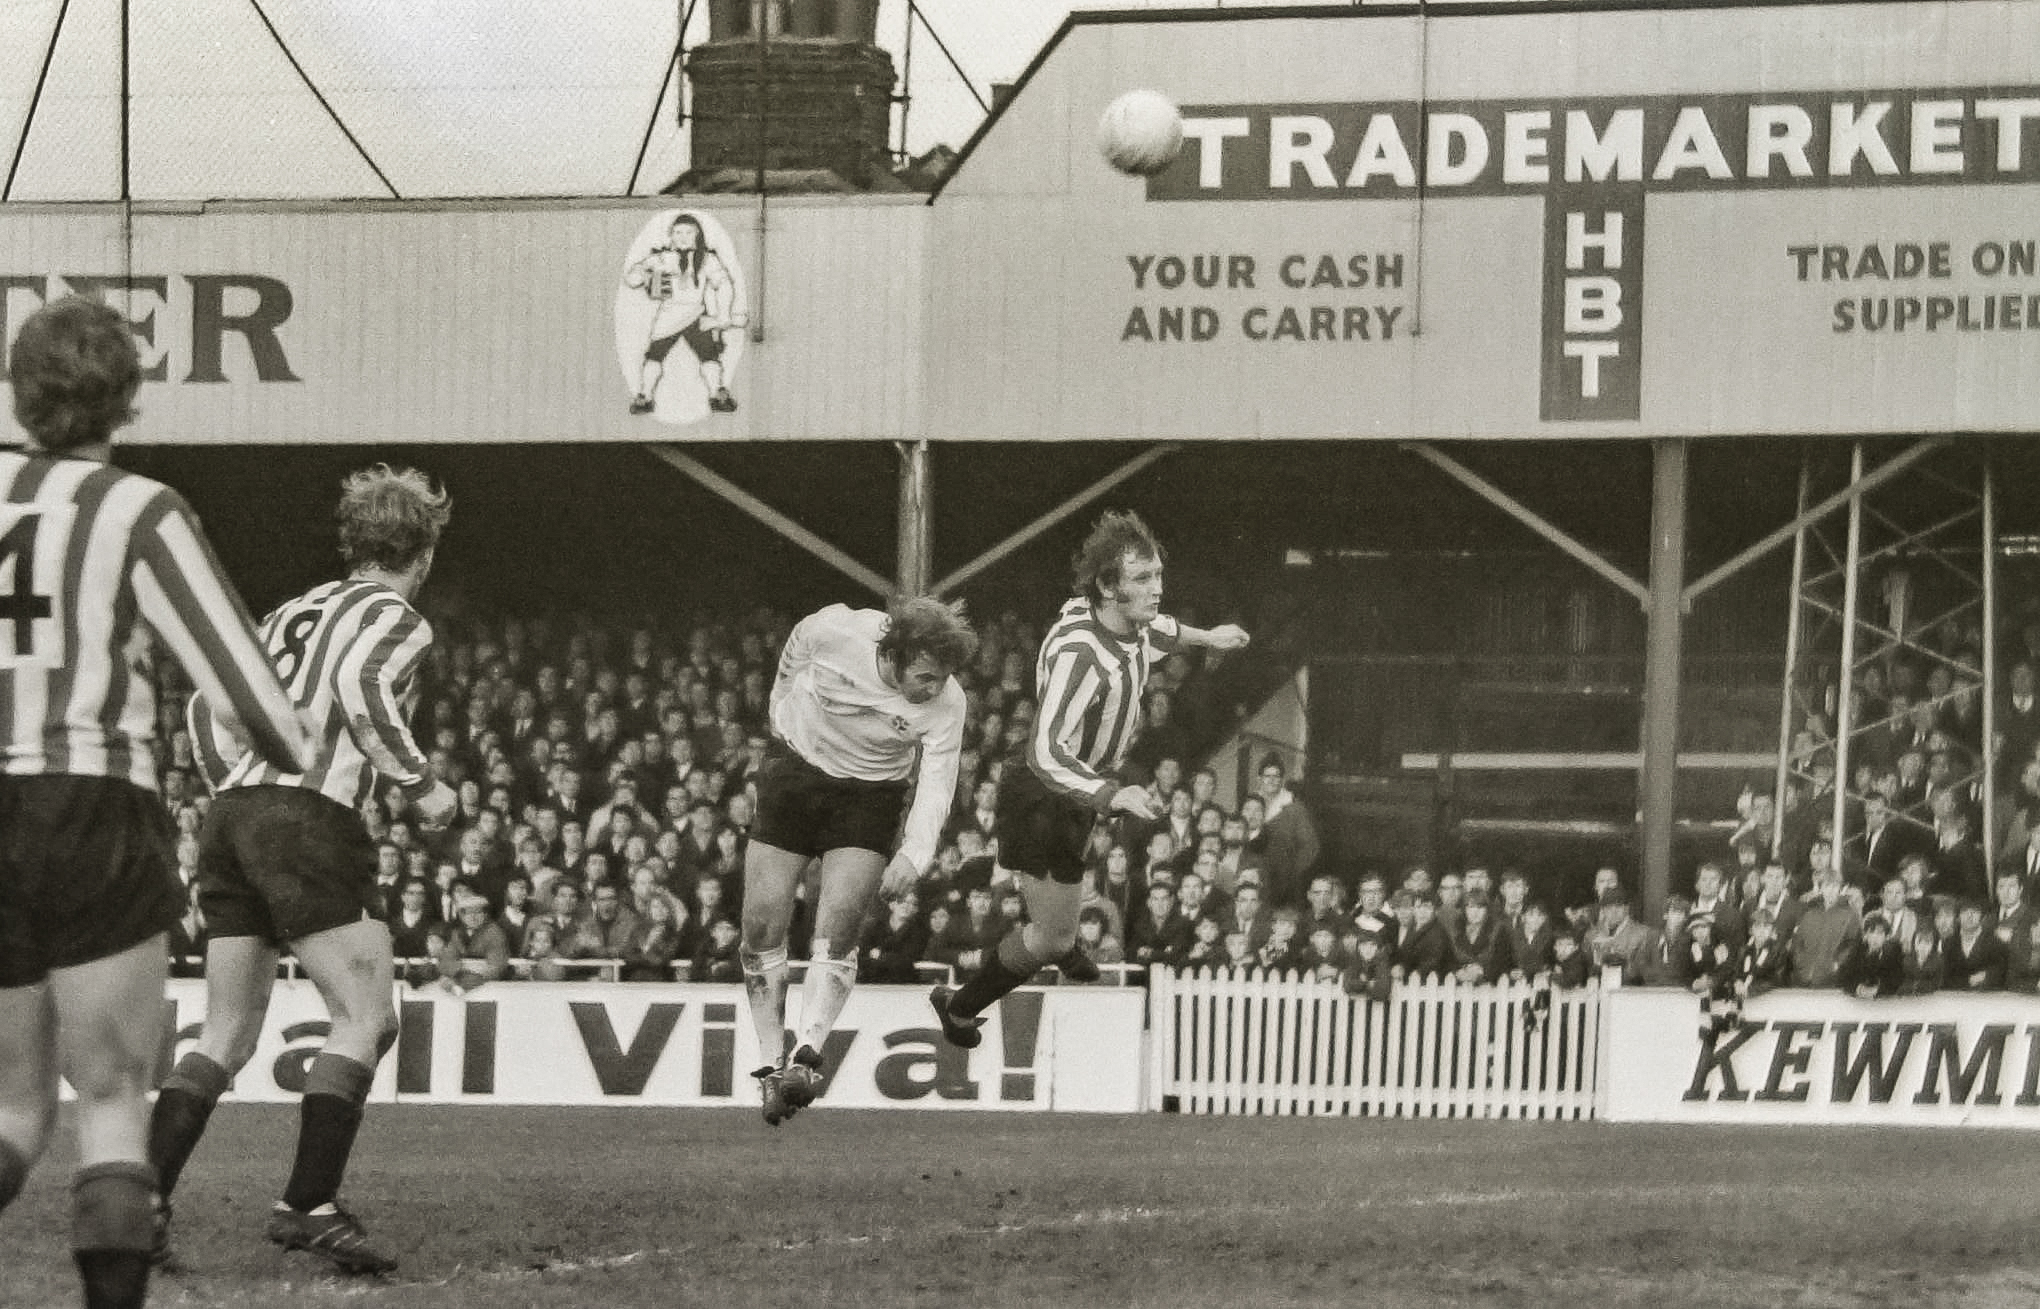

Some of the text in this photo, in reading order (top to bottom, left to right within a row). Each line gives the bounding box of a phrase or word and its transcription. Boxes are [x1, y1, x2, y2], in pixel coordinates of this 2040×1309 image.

[1182, 98, 2040, 189] TRADEMARKET
[1126, 254, 1404, 289] YOUR CASH
[1787, 240, 1952, 282] TRADE
[1120, 306, 1404, 342] AND CARRY
[0, 513, 52, 655] 4
[271, 609, 323, 692] 8
[158, 1000, 498, 1095] all
